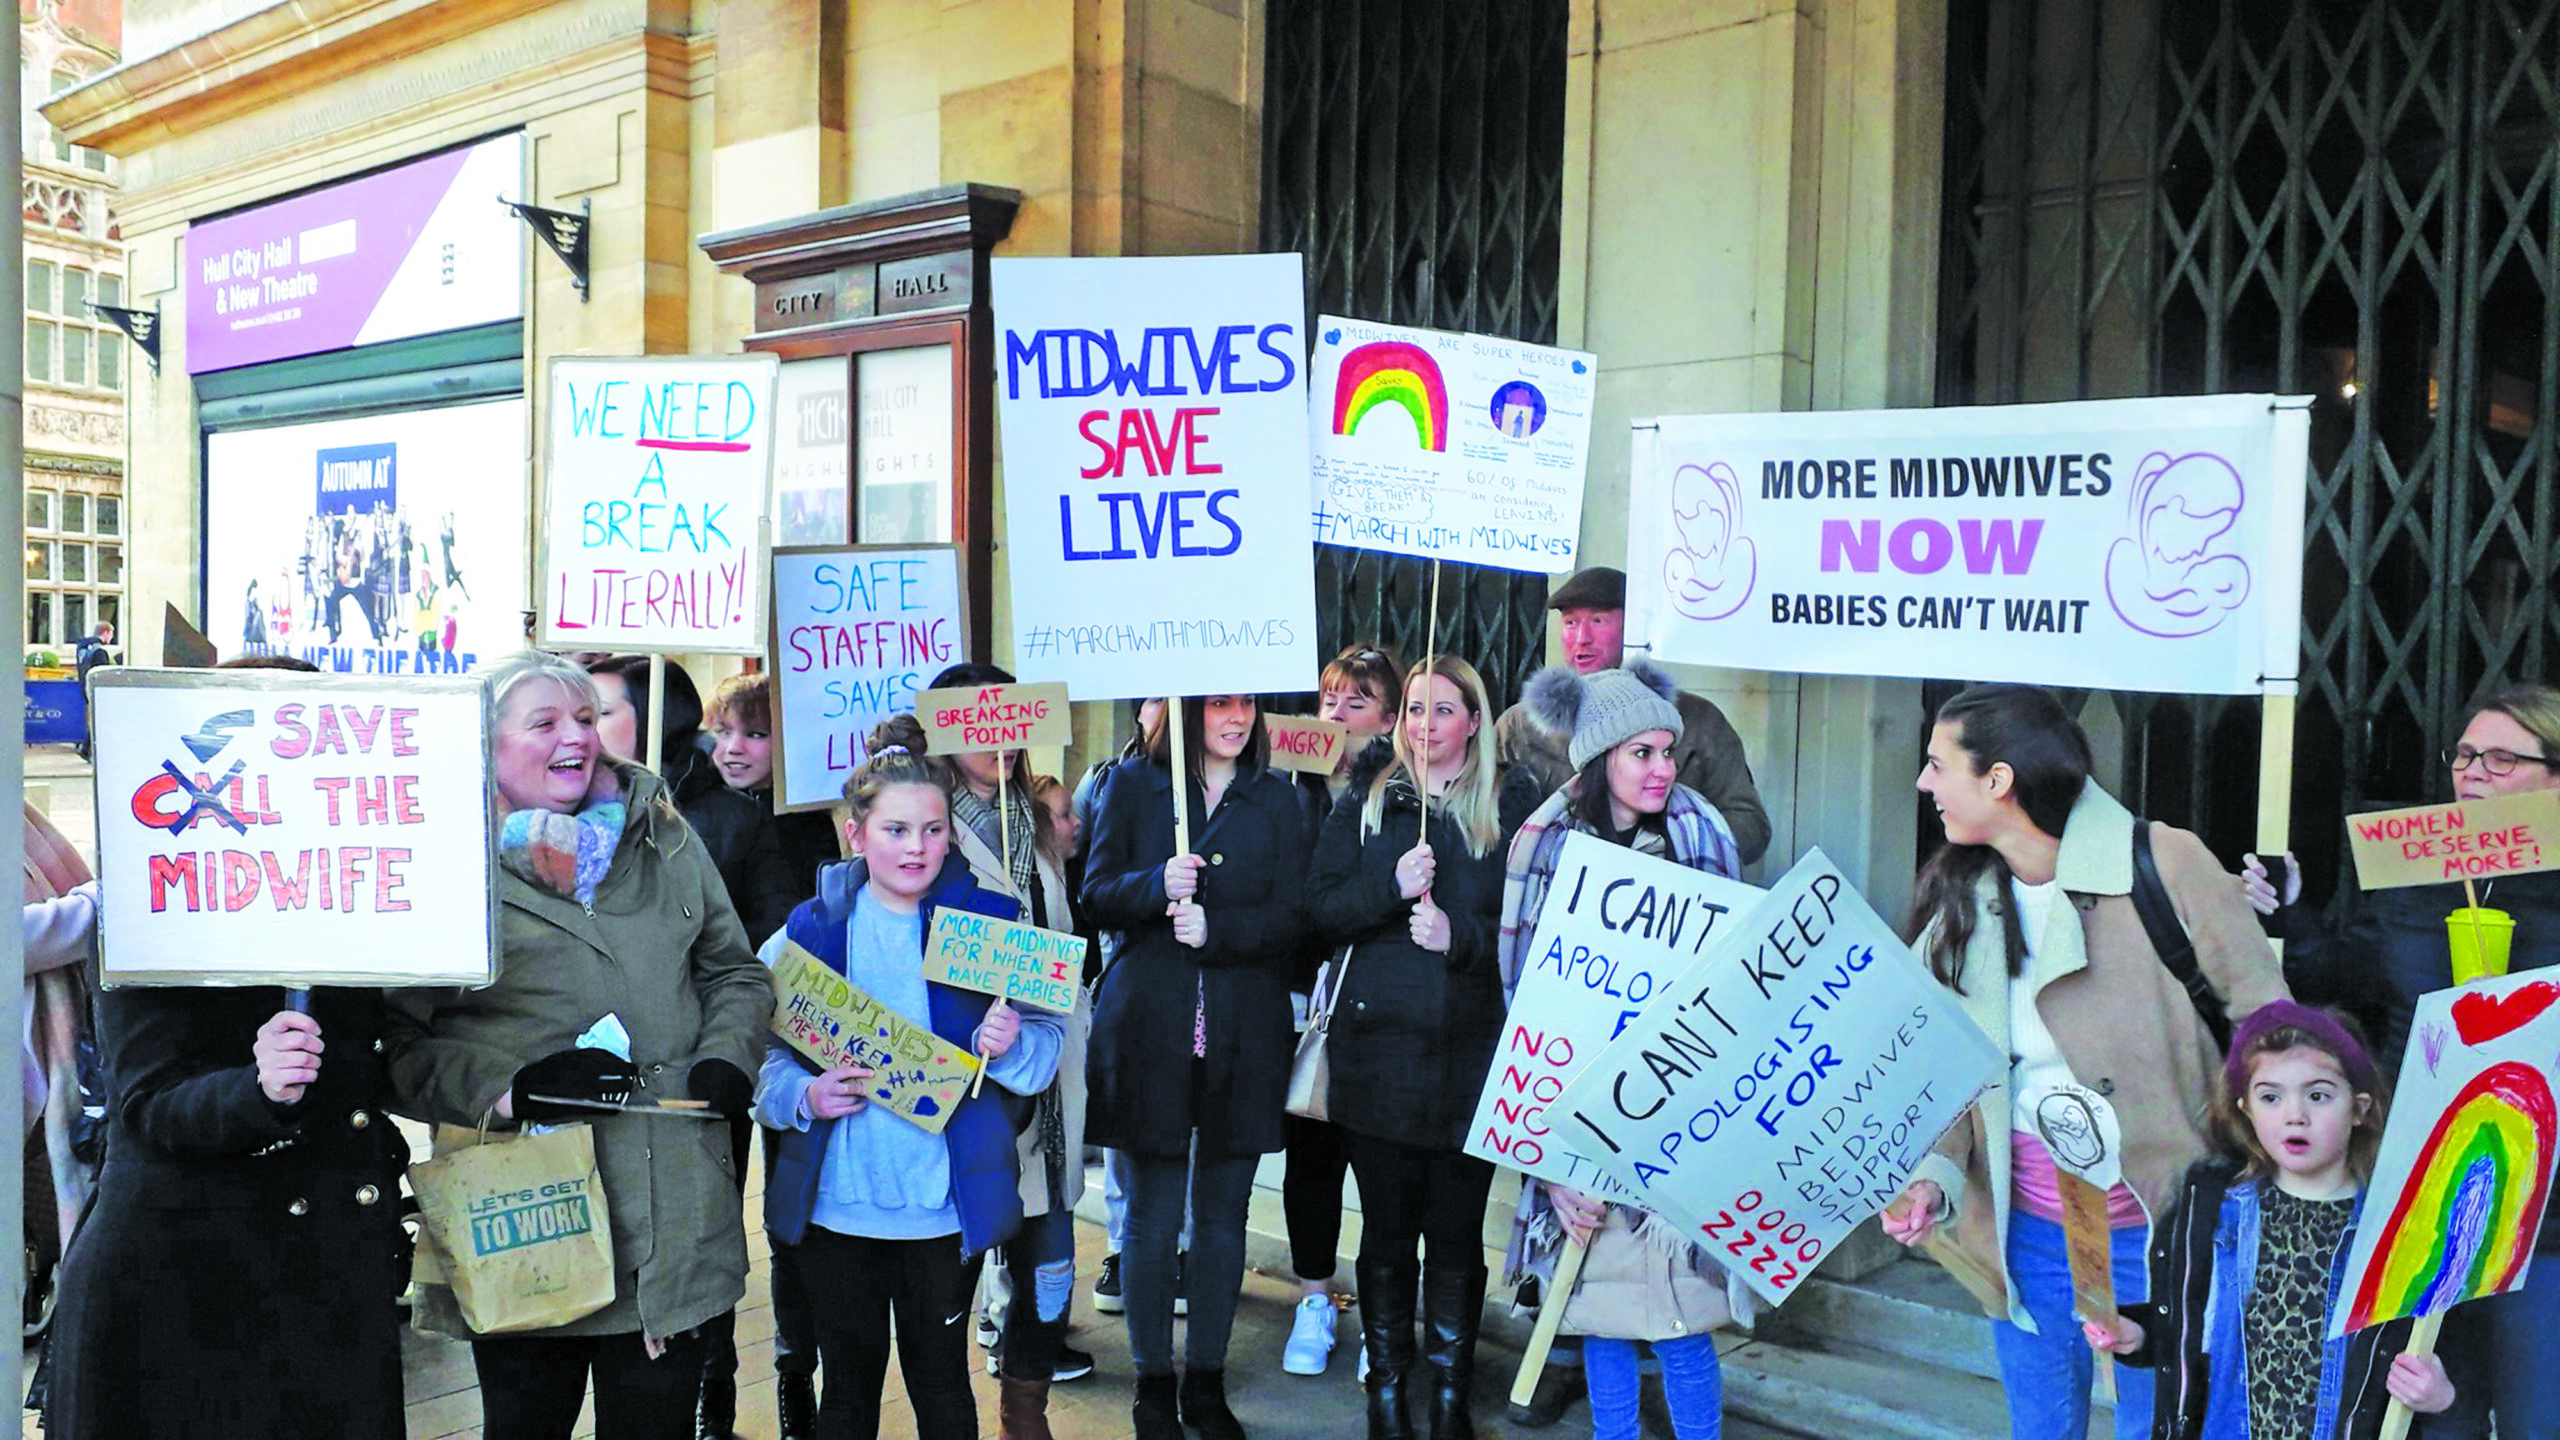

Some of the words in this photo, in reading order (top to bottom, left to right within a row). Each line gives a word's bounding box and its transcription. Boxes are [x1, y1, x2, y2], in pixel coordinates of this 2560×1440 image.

[203, 253, 230, 285] Hull
[232, 248, 261, 280] City
[264, 236, 292, 270] Hall
[216, 287, 227, 315] &
[229, 284, 260, 312] New
[262, 271, 318, 304] Theatre
[774, 292, 822, 315] CITY
[894, 273, 948, 298] HALL
[1006, 323, 1296, 399] MIDWIVES
[1438, 336, 1460, 351] ARE
[1473, 342, 1512, 359] SUPER
[1522, 349, 1567, 367] HEROES
[569, 381, 629, 438] WE
[640, 381, 755, 441] NEED
[804, 396, 838, 441] HCH
[895, 384, 919, 409] CITY
[1079, 407, 1223, 479] SAVE
[321, 460, 372, 492] AUTUMN
[373, 455, 391, 488] AT
[634, 452, 667, 499] A
[1332, 480, 1376, 500] GIVE
[1467, 469, 1495, 487] 60%
[1761, 460, 1876, 499] MORE
[1890, 453, 2112, 498] MIDWIVES
[584, 500, 731, 552] BREAK
[1060, 489, 1242, 561] LIVES
[1312, 500, 1407, 546] #MARCH
[1417, 528, 1460, 549] WITH
[1470, 526, 1572, 555] MIDWIVES
[1819, 518, 2045, 575] NOW
[556, 546, 746, 629] LITERALLY!
[810, 560, 927, 613] SAFE
[1771, 594, 1887, 628] BABIES
[1898, 595, 1995, 631] CAN'T
[2004, 599, 2089, 634] WAIT
[790, 618, 952, 672] STAFFING
[1024, 619, 1295, 658] #MARCHWITHMIDWIVES
[824, 672, 920, 718] SAVES
[936, 700, 1049, 727] BREAKING
[978, 688, 1004, 704] AT
[270, 703, 420, 759] SAVE
[964, 723, 1034, 746] POINT
[131, 771, 282, 829] CALL
[314, 776, 425, 826] THE
[2357, 808, 2465, 842] WOMEN
[2402, 825, 2535, 860] DESERVE
[149, 847, 412, 913] MIDWIFE
[1568, 865, 1587, 915] I
[1600, 877, 1731, 955] CAN'T
[940, 914, 995, 941] MORE
[1003, 928, 1085, 964] MIDWIVES
[941, 937, 982, 963] FOR
[993, 948, 1044, 975] WHEN
[1050, 962, 1068, 981] I
[948, 965, 998, 989] HAVE
[1006, 973, 1072, 1007] BABIES
[1537, 935, 1674, 1003] APOLO
[789, 1015, 811, 1039] ME
[790, 963, 935, 1063] MIDWIVES
[1573, 1109, 1622, 1154] I
[1612, 986, 1739, 1120] CAN'T
[1741, 874, 1841, 1001] KEEP
[844, 1035, 893, 1066] KEEP
[1511, 1026, 1573, 1066] NO
[1633, 943, 1876, 1190] APOLOGISING
[1501, 1064, 1563, 1102] NO
[1755, 1043, 1843, 1137] FOR
[1483, 1126, 1542, 1165] NO
[1701, 1190, 1762, 1240] NO
[1777, 1005, 1928, 1181] MIDWIVES
[468, 1188, 534, 1214] LET'S
[539, 1179, 586, 1197] GET
[1726, 1210, 1785, 1256] NO
[1797, 1113, 1882, 1202] BEDS
[1749, 1223, 1806, 1273] NO
[1819, 1080, 1935, 1217] SUPPORT
[473, 1215, 510, 1251] TO
[513, 1198, 588, 1242] WORK
[1770, 1238, 1822, 1289] NO
[1831, 1146, 1919, 1224] TIME
